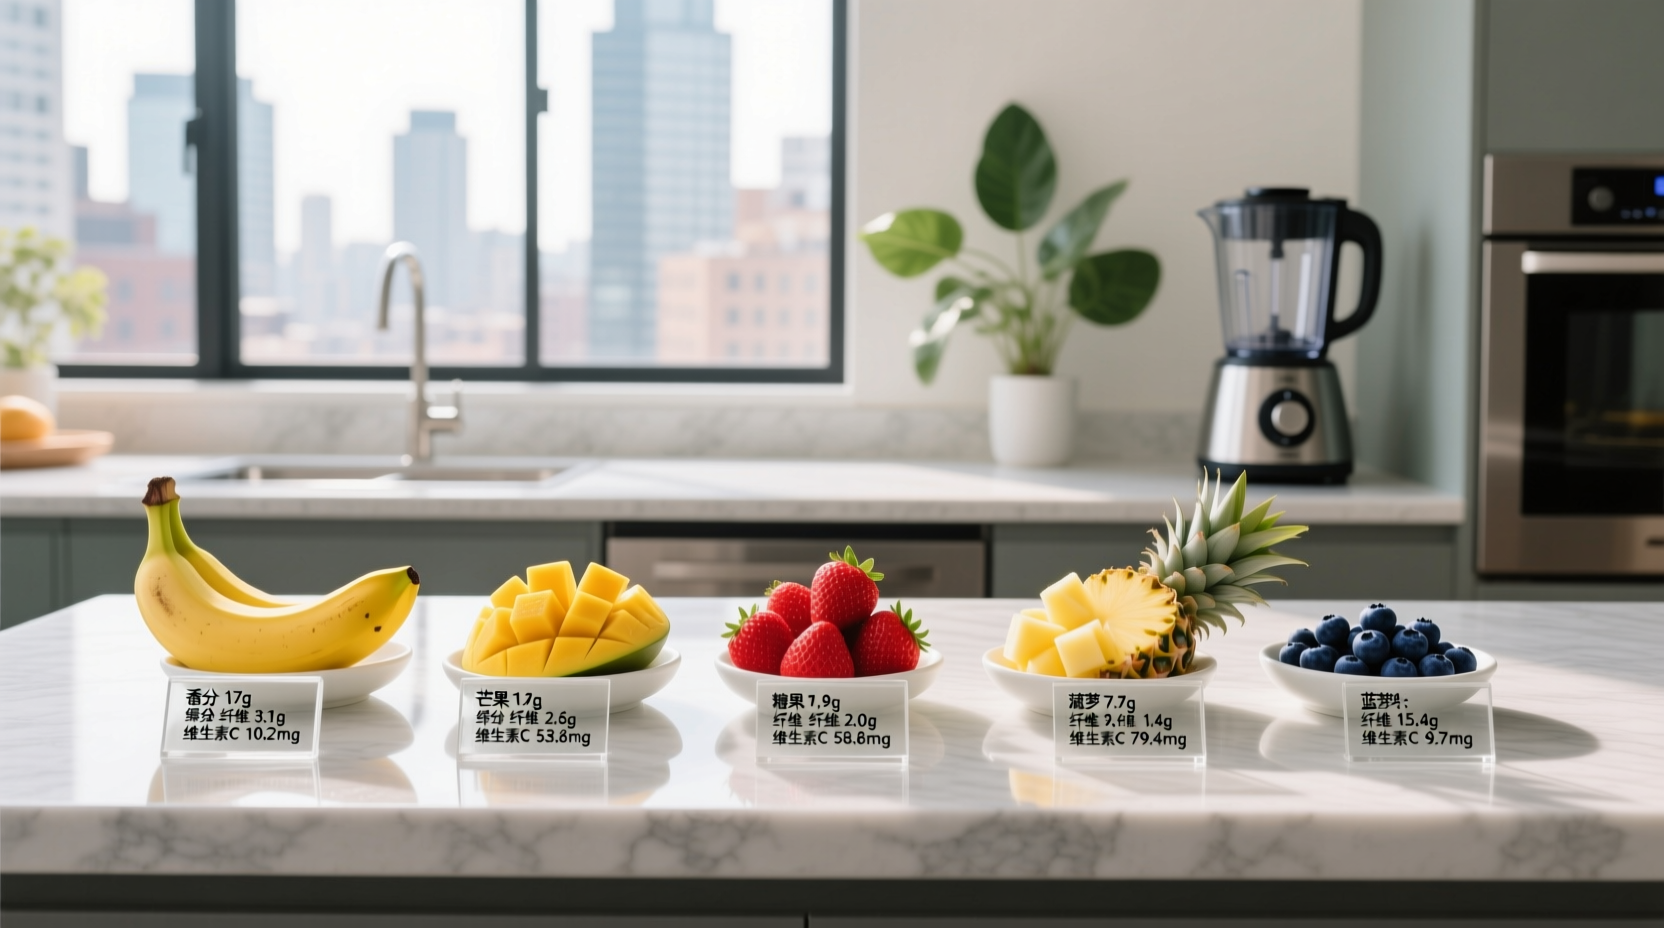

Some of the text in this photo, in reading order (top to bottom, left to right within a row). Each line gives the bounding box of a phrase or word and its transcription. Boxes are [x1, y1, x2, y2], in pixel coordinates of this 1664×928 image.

[225, 690, 251, 708] 17g
[475, 688, 509, 709] 芒果
[1103, 695, 1135, 713] 7.7g
[254, 710, 285, 726] 3.1g
[545, 711, 576, 729] 2.6g
[844, 713, 876, 730] 2.0g
[1144, 714, 1172, 730] 1.4g
[1397, 712, 1438, 730] 15.4g
[182, 724, 300, 744] 维生素C 10.2mg
[536, 729, 590, 747] 53.8mg
[772, 729, 827, 746] 维生素C
[1069, 731, 1186, 750] 维生素C 79.4mg
[1361, 729, 1473, 749] 维生素C 9.7mg
